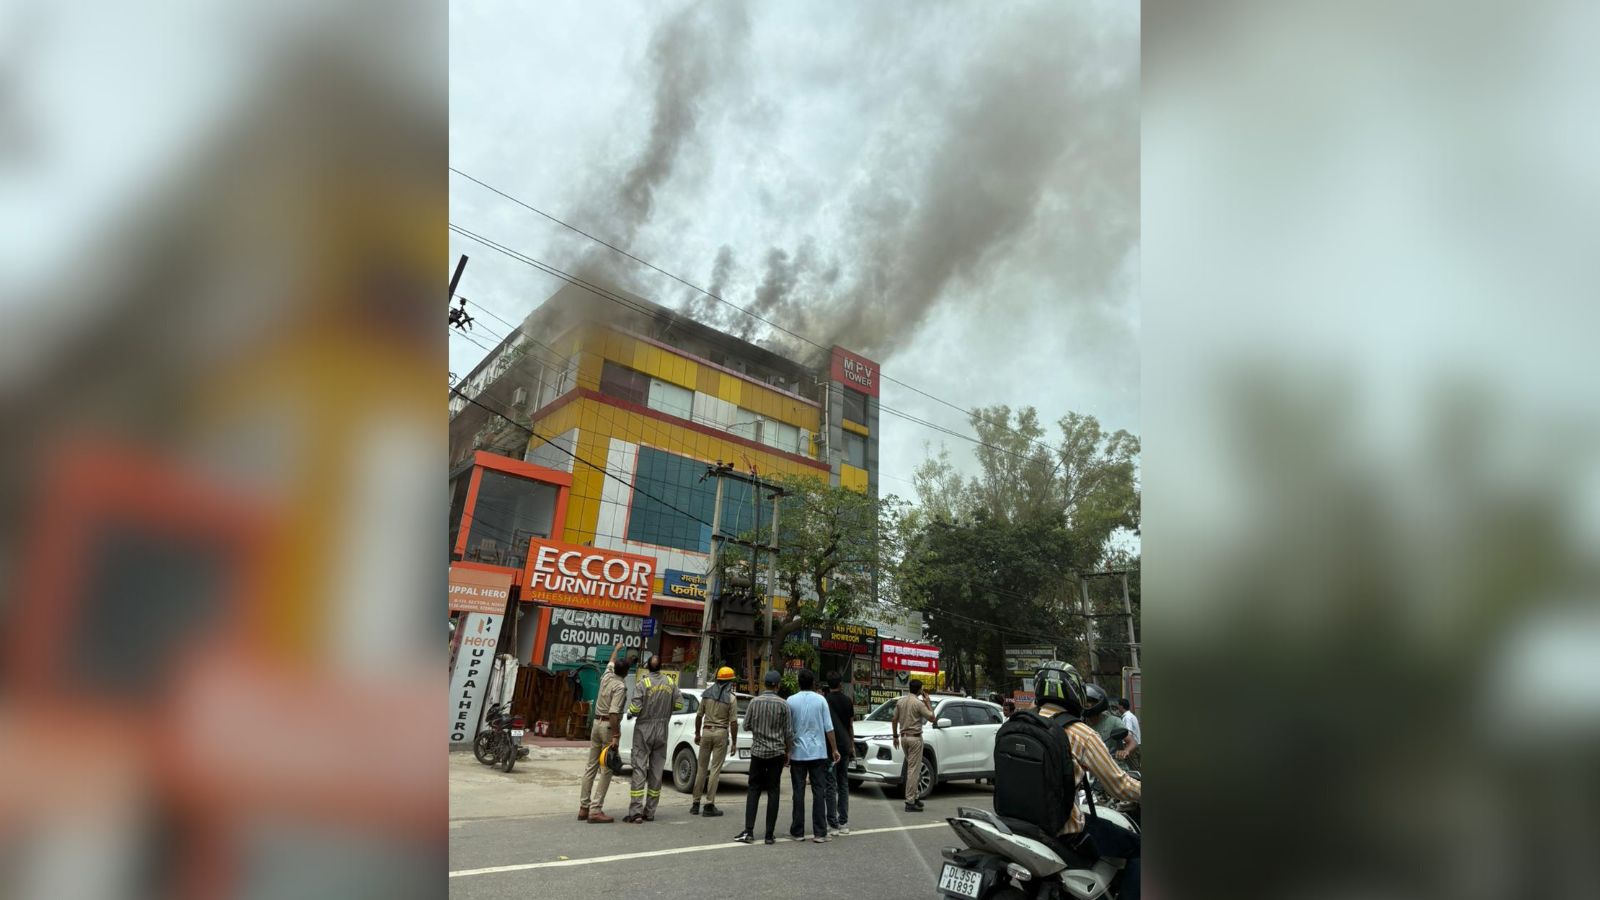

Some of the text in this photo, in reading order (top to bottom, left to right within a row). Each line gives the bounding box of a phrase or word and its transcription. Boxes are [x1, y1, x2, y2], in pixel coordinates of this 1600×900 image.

[844, 369, 873, 387] TOWER
[534, 545, 652, 587] ECCOR
[449, 585, 507, 599] UPPAL HERO
[530, 572, 649, 603] FURNITURE
[531, 590, 643, 612] SHEESHAM FURNITURE
[560, 629, 610, 646] GROUND
[949, 867, 977, 884] DL3SC
[946, 879, 974, 895] A1893
